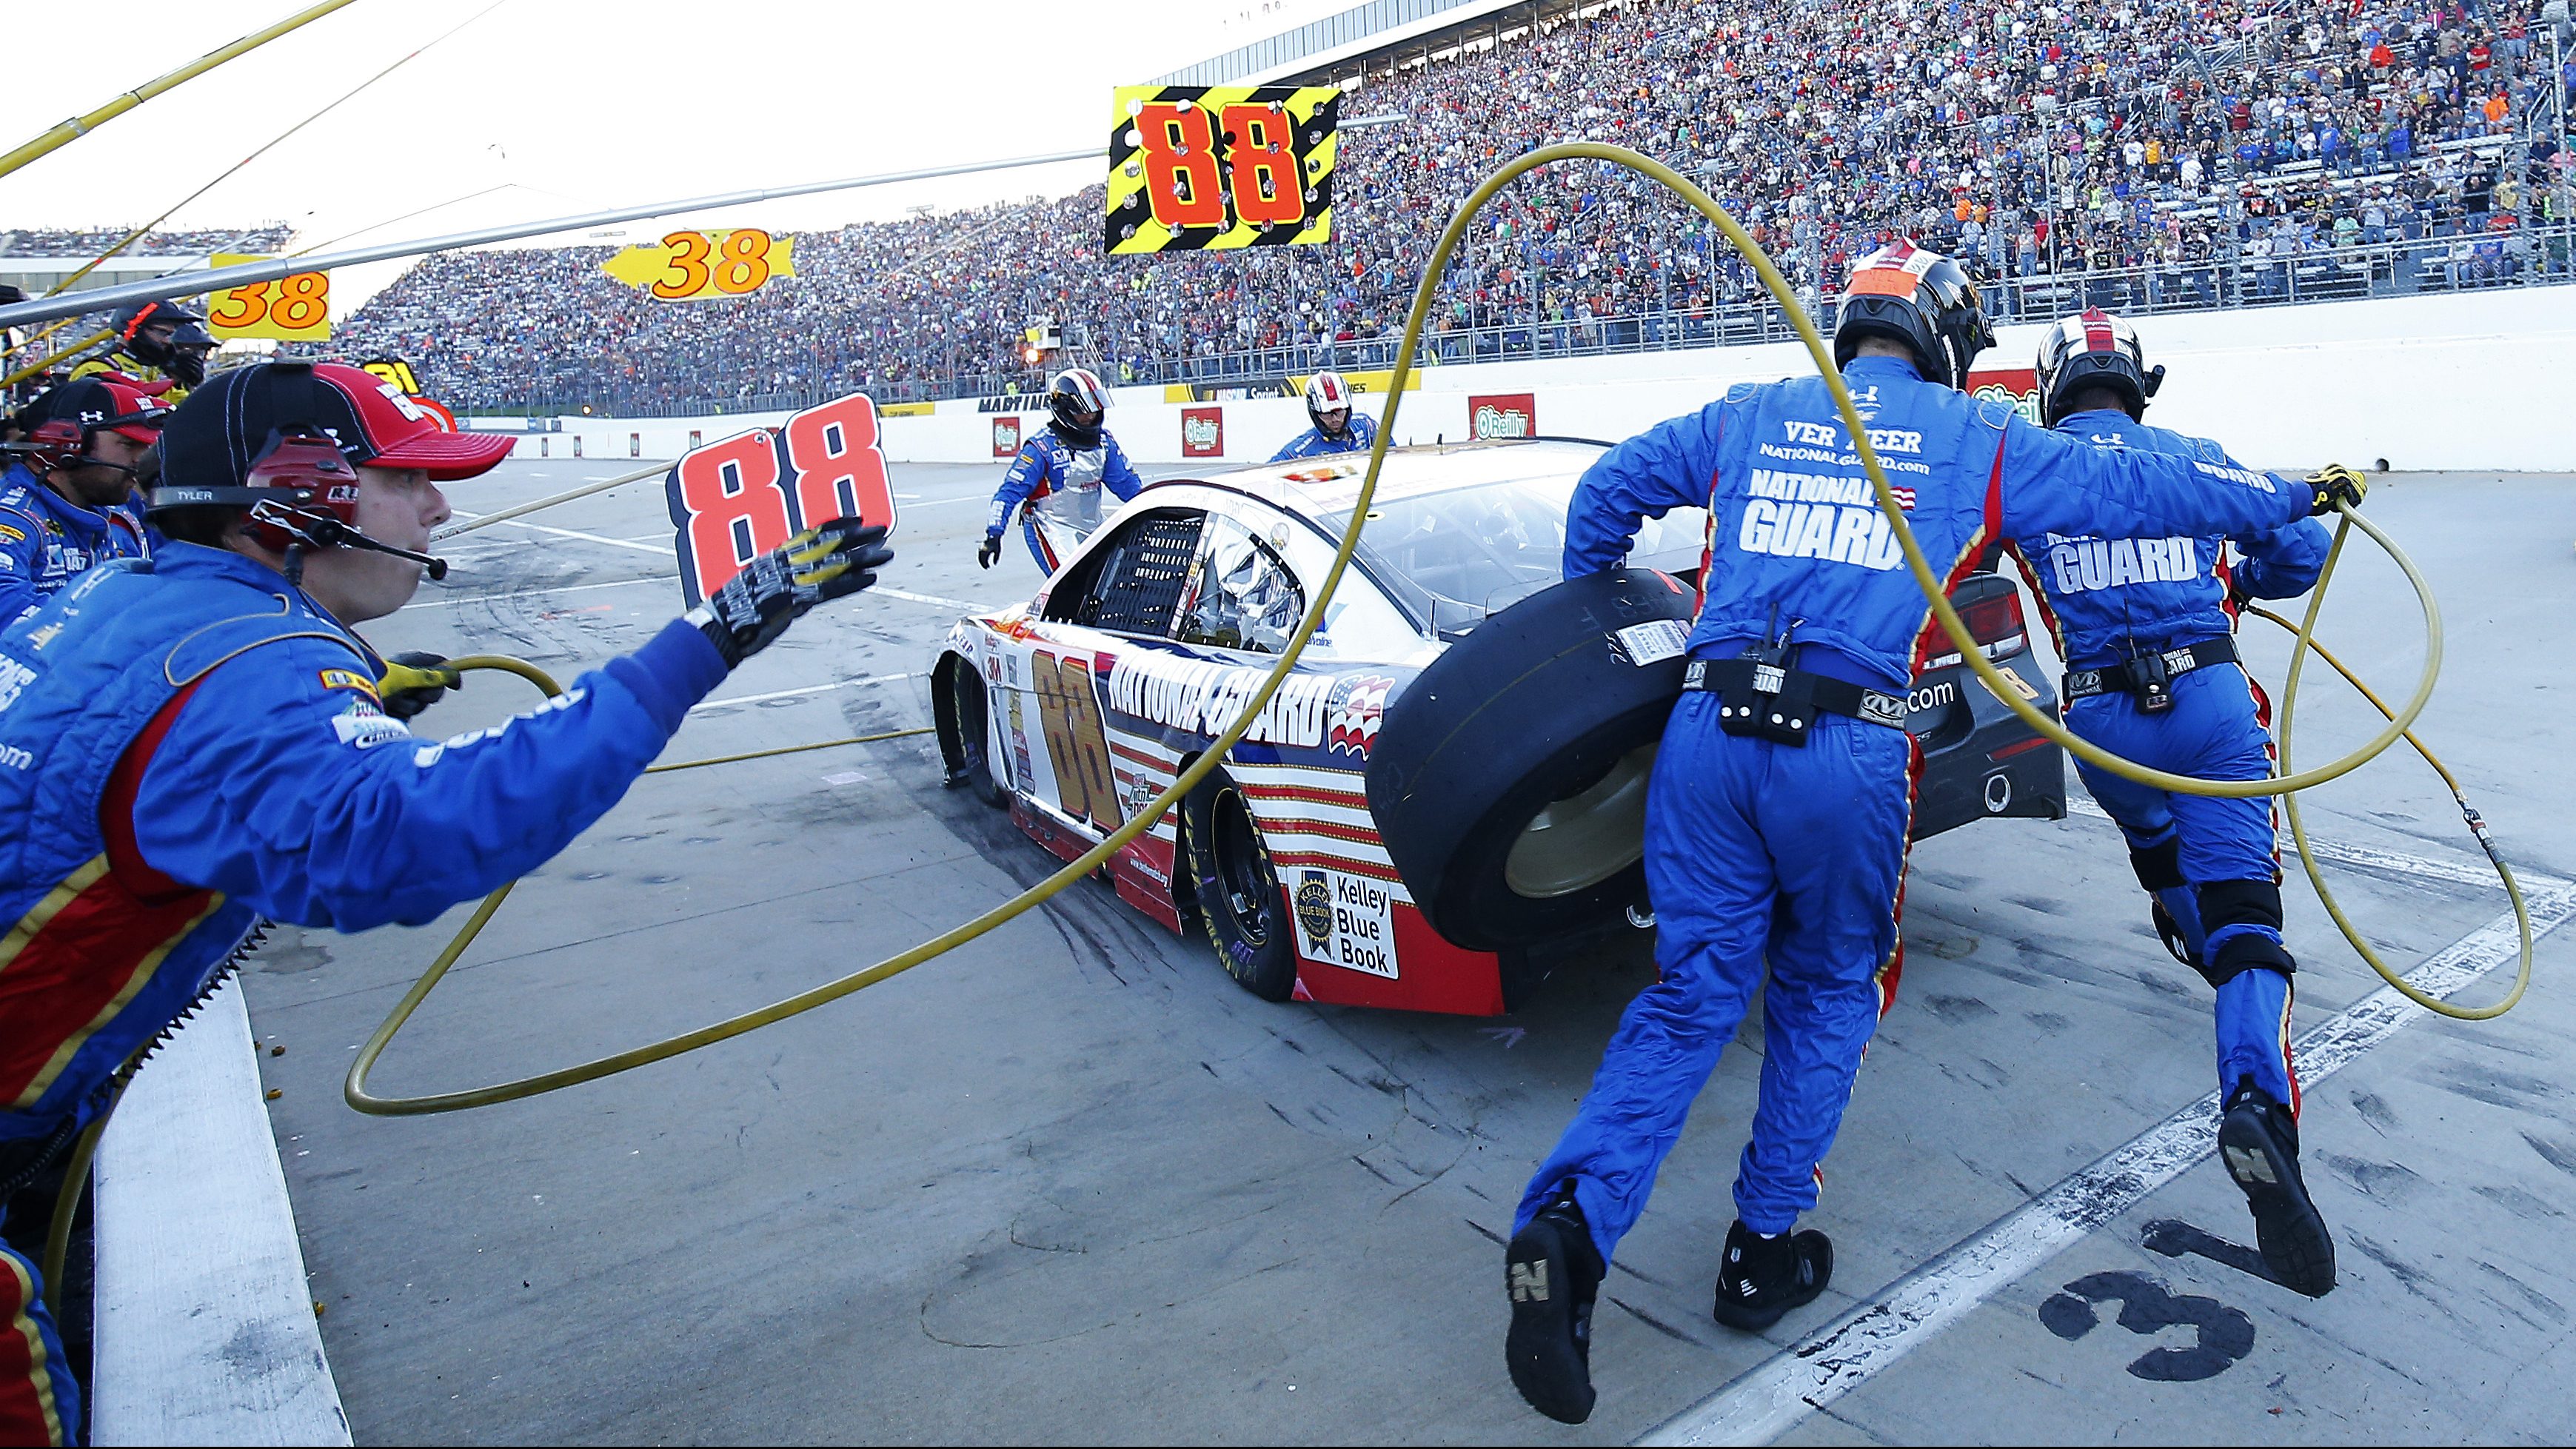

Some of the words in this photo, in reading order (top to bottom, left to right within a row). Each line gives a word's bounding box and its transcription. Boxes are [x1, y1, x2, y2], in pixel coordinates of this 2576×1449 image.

[1132, 101, 1305, 229] 88
[652, 228, 771, 299] 38
[210, 271, 329, 329] 38
[1186, 419, 1217, 443] O'Reilly
[1478, 410, 1525, 438] O'Reilly
[178, 491, 213, 501] TYLER
[677, 392, 898, 601] 88
[1747, 468, 1876, 507] NATIONAL
[1739, 499, 1910, 571] GUARD
[2051, 535, 2198, 594] GUARD
[1108, 651, 1216, 733] NATIONAL
[1205, 668, 1336, 747] GUARD
[1032, 649, 1123, 831] 88
[1299, 905, 1316, 917] BLUE
[1315, 906, 1331, 918] BOOK
[1300, 886, 1330, 904] KELLEY
[1336, 876, 1387, 917] Kelley
[1336, 908, 1380, 941] Blue
[1340, 937, 1390, 974] Book
